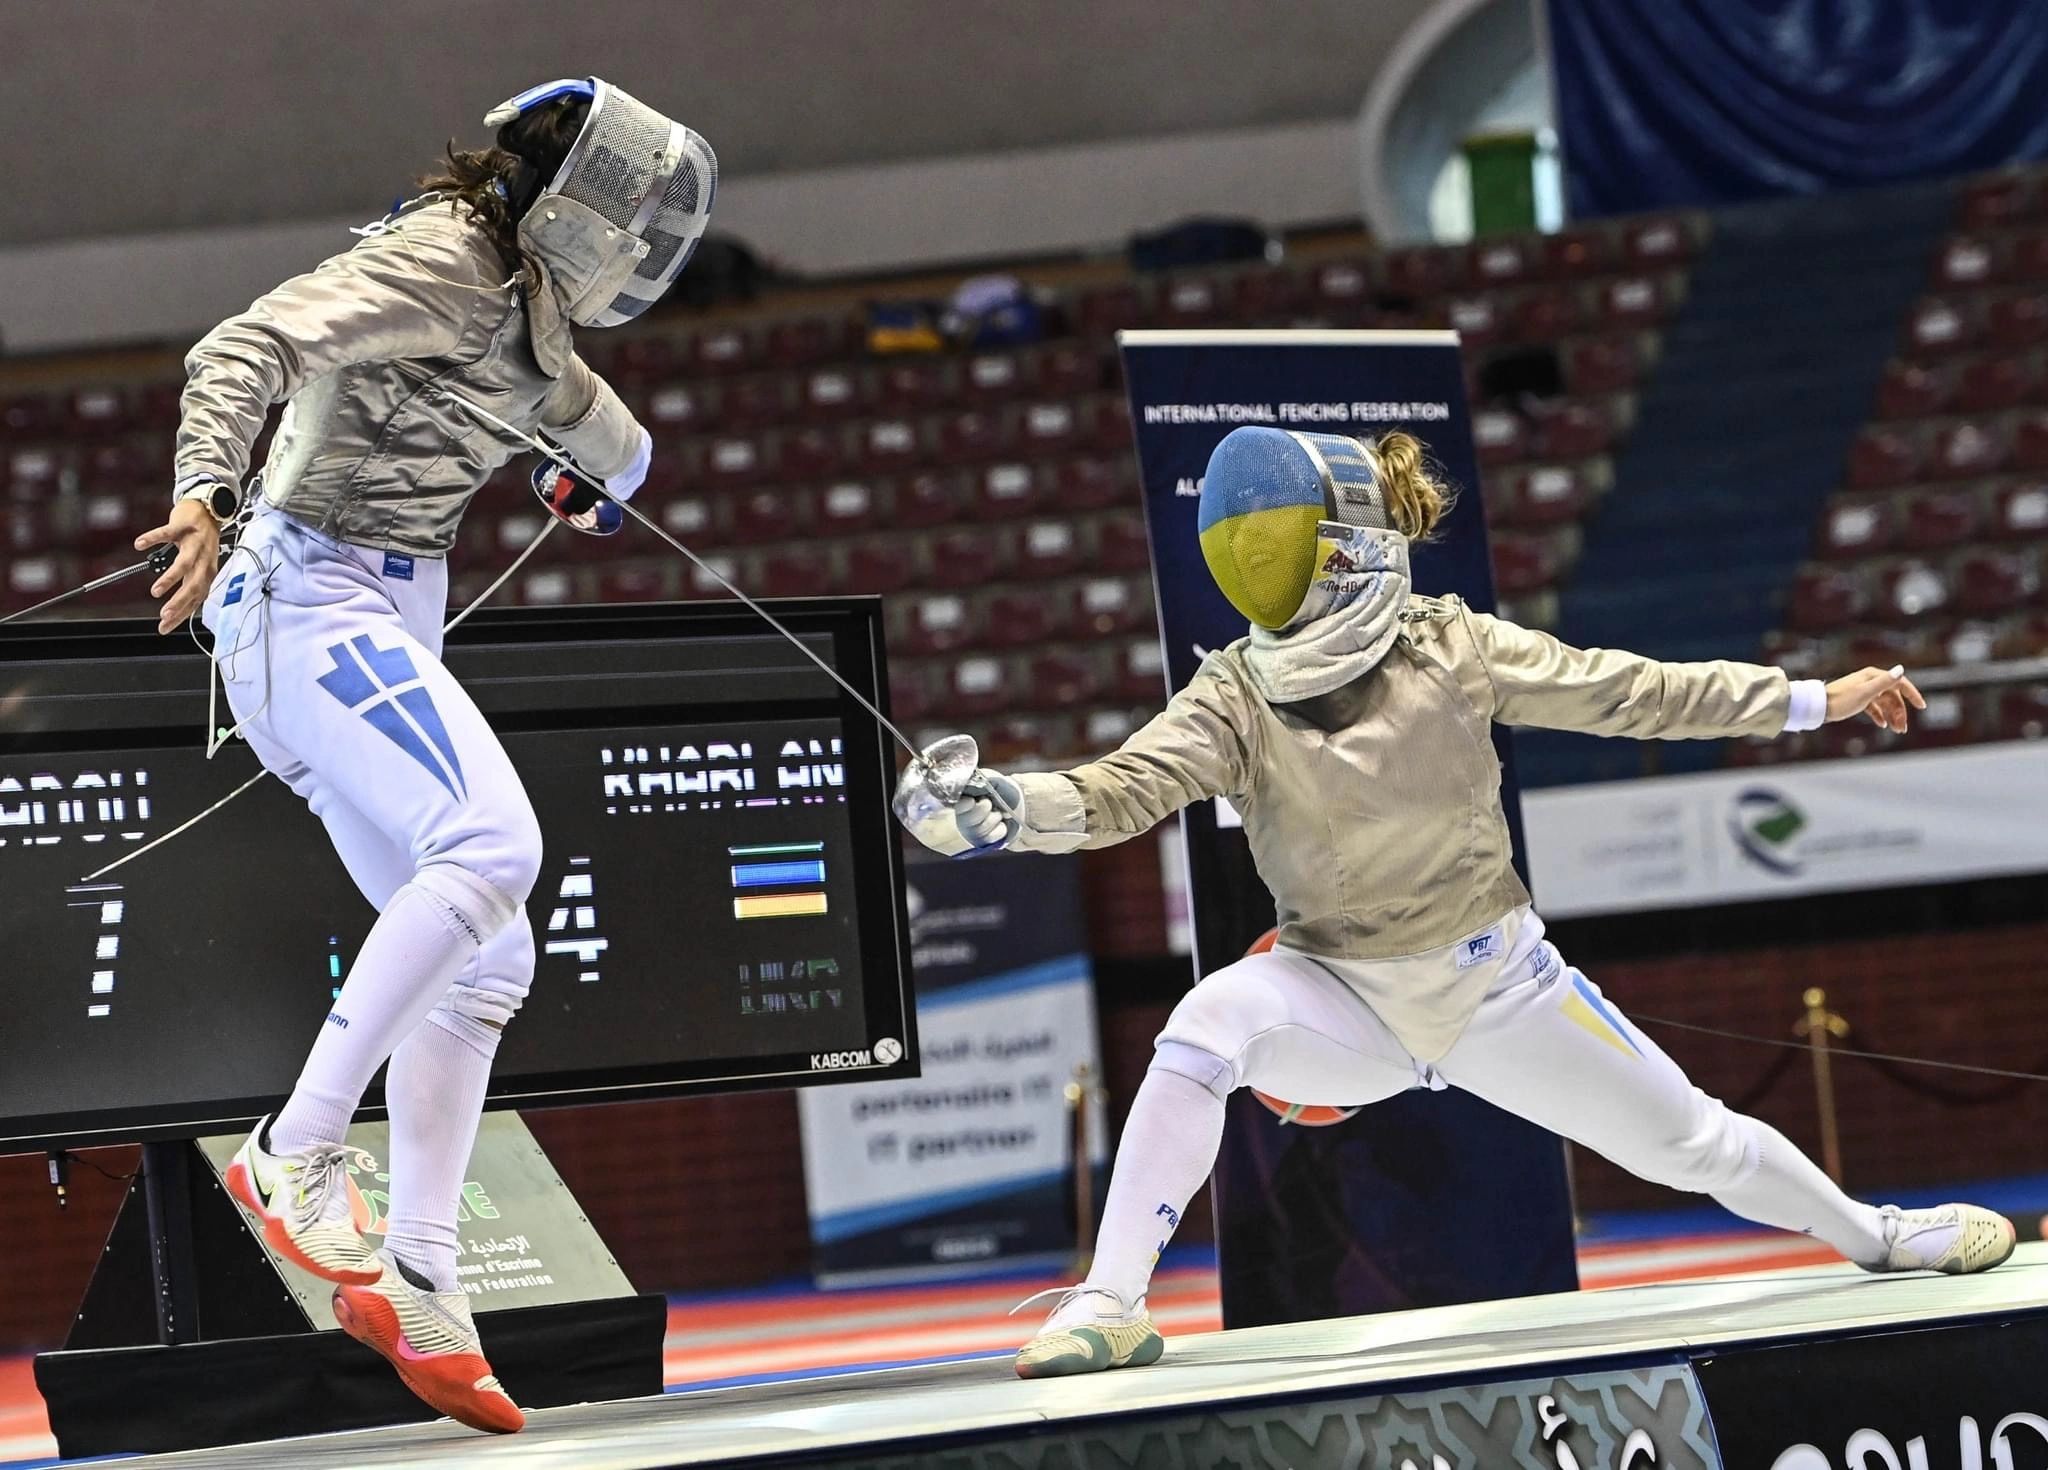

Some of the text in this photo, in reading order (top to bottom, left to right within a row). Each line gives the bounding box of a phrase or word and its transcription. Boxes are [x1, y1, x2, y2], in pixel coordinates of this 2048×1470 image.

[1144, 402, 1449, 423] INTERNATIONAL FENCING FEDERATION
[1468, 935, 1492, 955] PBT
[811, 1051, 871, 1070] KABCOM
[906, 1125, 1036, 1163] partner
[482, 1275, 554, 1291] Federation
